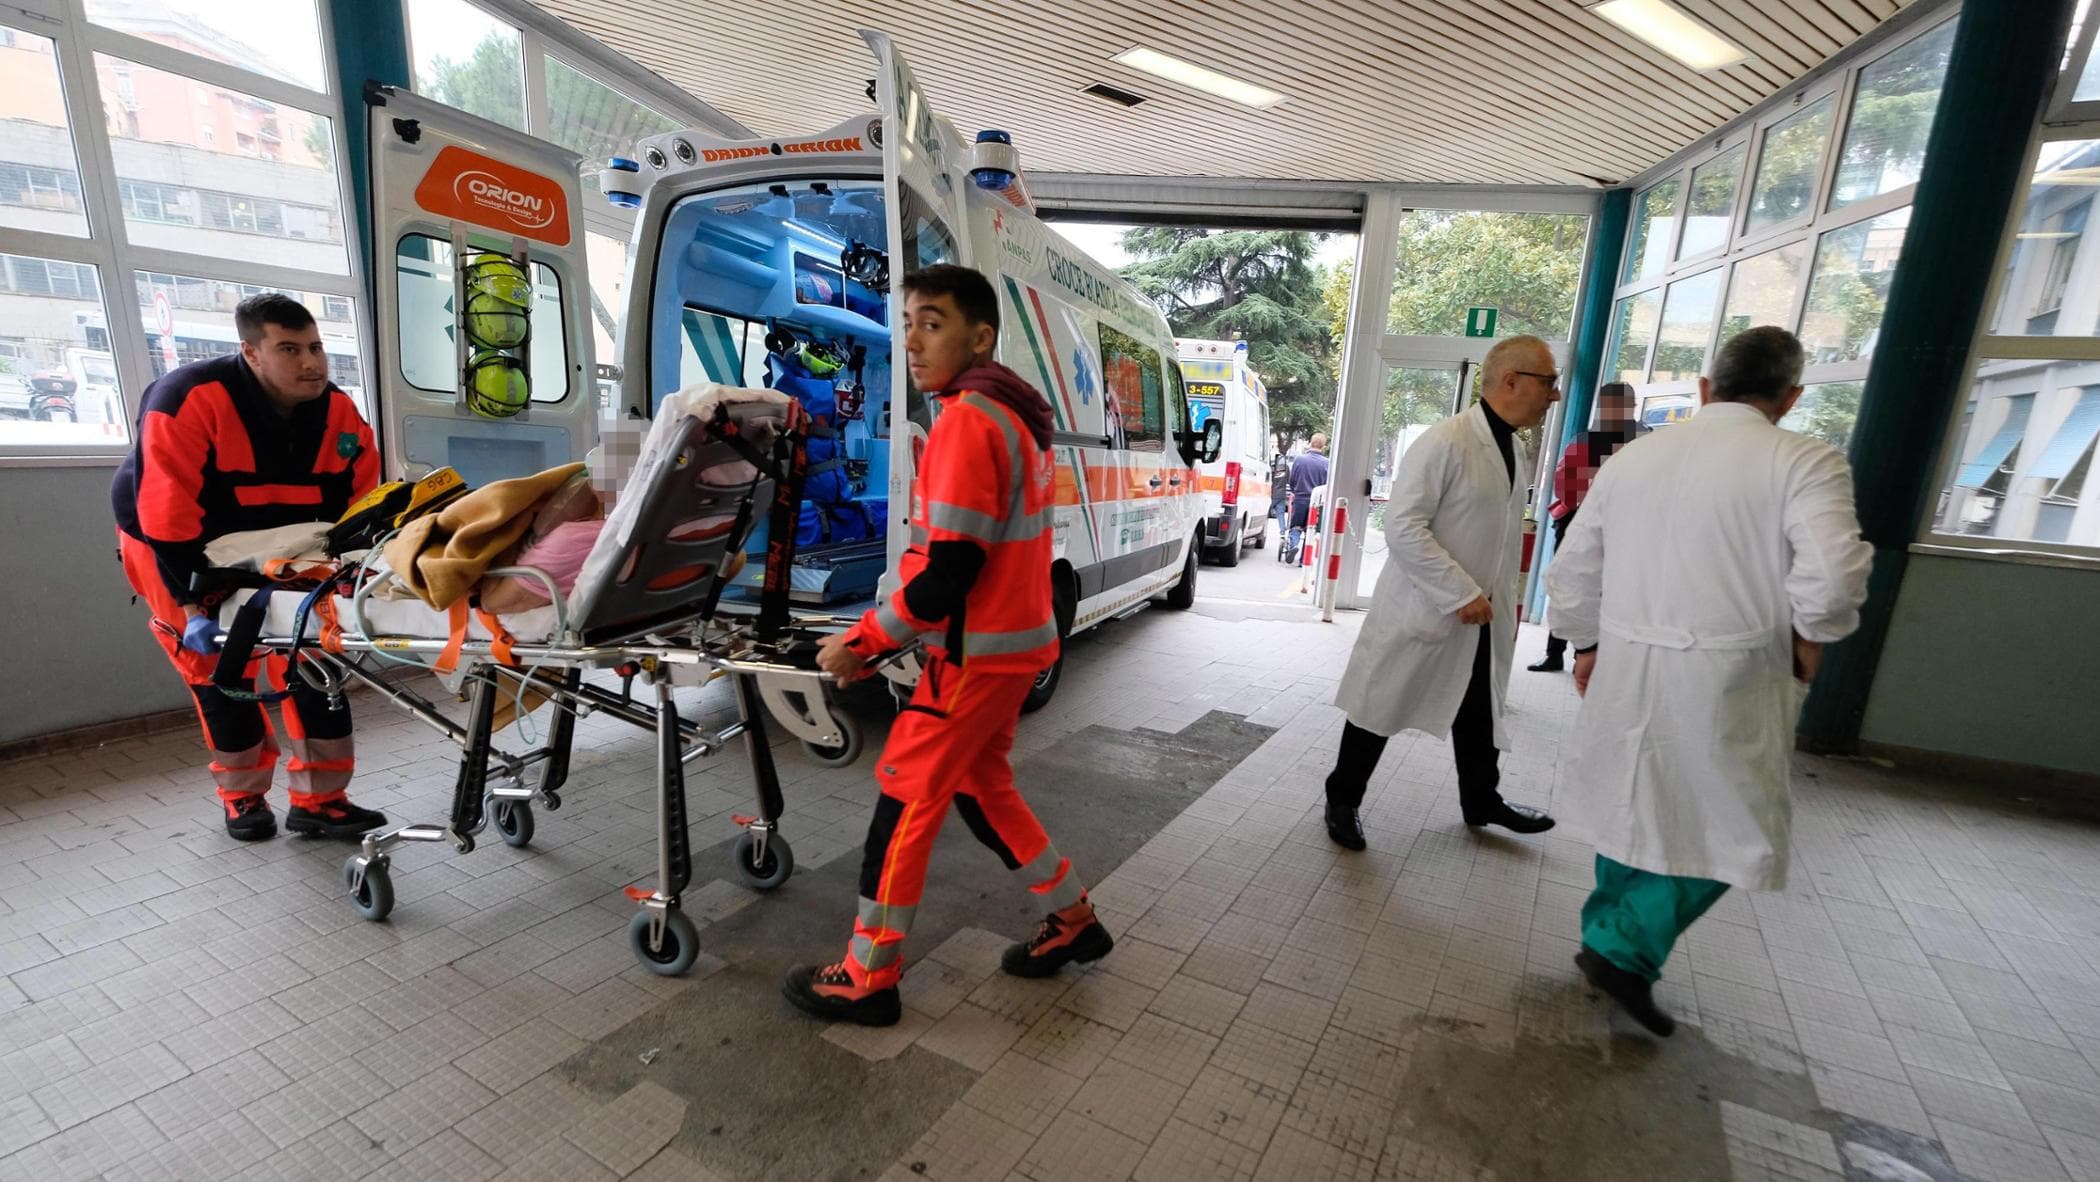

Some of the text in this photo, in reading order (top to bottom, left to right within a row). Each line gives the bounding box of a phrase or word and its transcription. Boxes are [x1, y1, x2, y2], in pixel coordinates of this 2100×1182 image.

[783, 137, 864, 153] ORION
[468, 179, 542, 211] ORION
[1046, 246, 1085, 298] CROCE
[1189, 385, 1220, 395] 3-557
